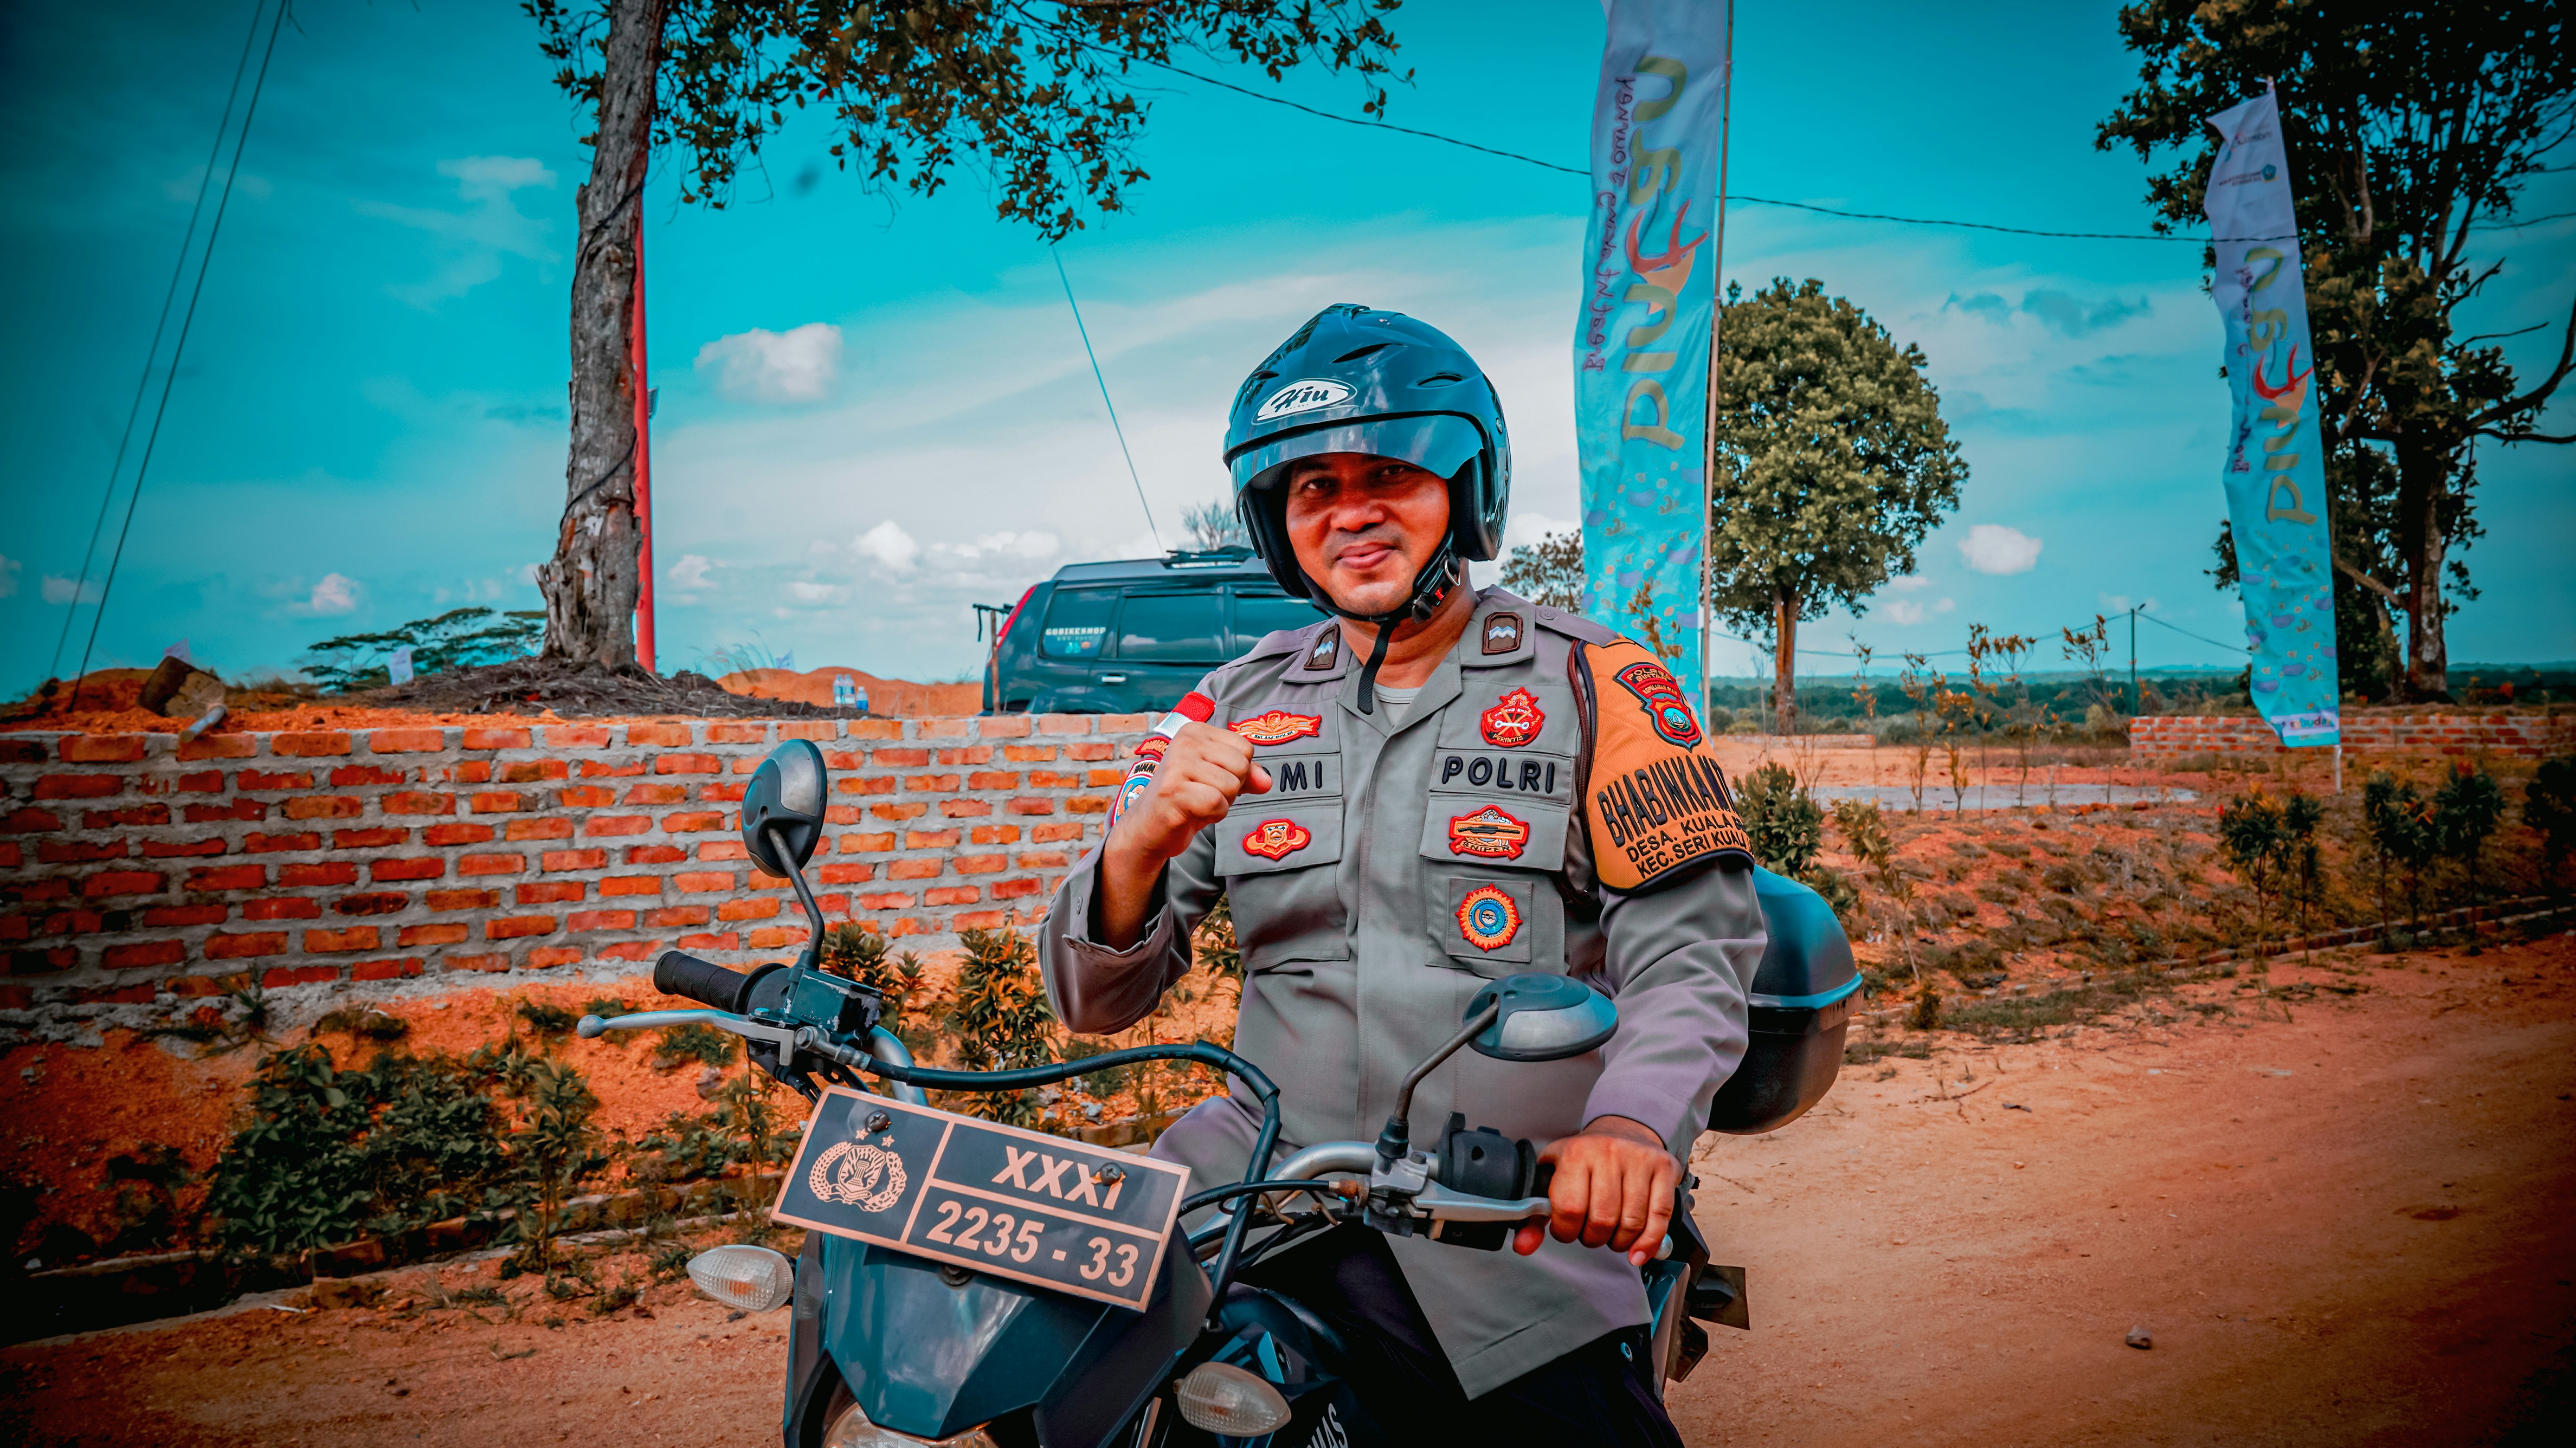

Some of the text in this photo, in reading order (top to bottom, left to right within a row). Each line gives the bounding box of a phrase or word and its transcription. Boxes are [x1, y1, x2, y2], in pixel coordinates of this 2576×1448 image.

[1271, 386, 1329, 412] Hiu
[1492, 733, 1524, 743] PERINTIS
[1441, 756, 1555, 794] POLRI
[1463, 842, 1510, 852] SNIPER
[1626, 831, 1678, 862] DESA.
[1680, 814, 1733, 836] KUALA
[991, 1146, 1125, 1210] XXXI
[926, 1200, 1045, 1263] 2235
[1080, 1237, 1138, 1287] 33
